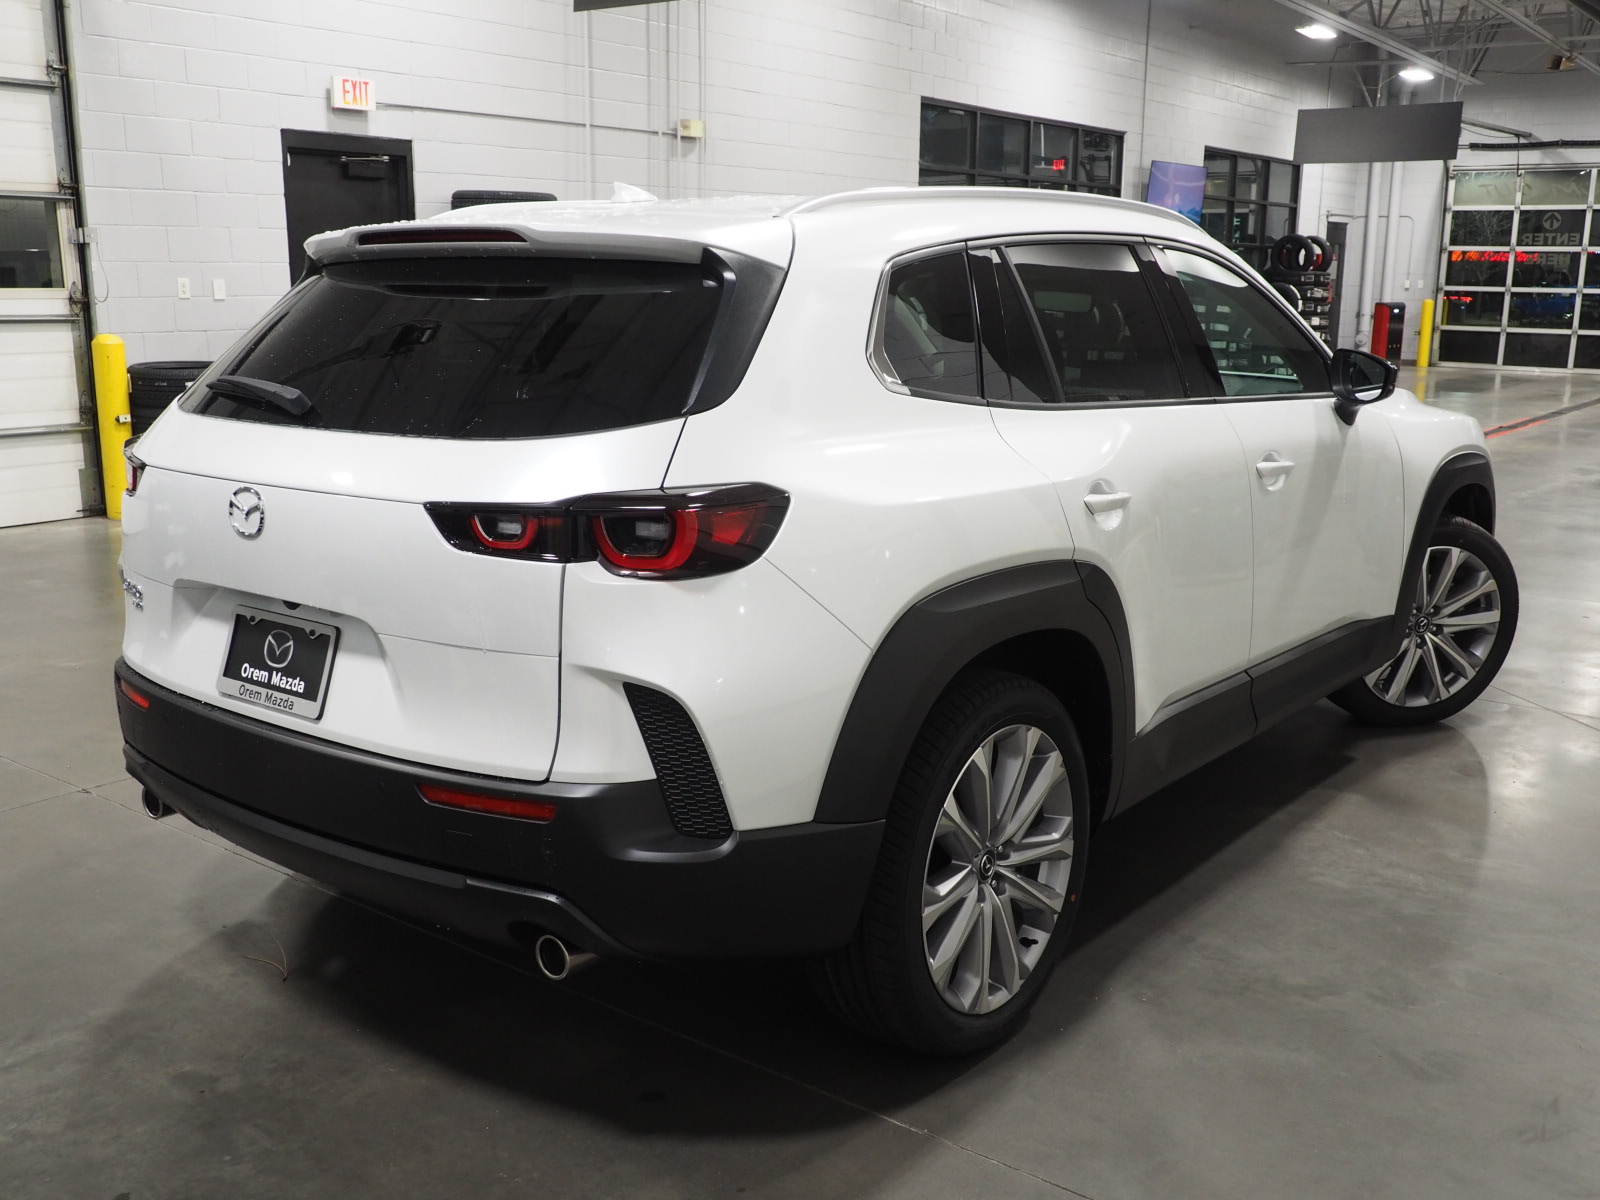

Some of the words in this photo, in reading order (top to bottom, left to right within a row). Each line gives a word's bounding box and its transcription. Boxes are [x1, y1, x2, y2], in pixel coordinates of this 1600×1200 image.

[342, 79, 369, 107] EXIT
[241, 662, 268, 683] Orem
[271, 671, 305, 693] Mazda
[238, 684, 262, 702] Orem
[264, 691, 295, 711] Mazda
